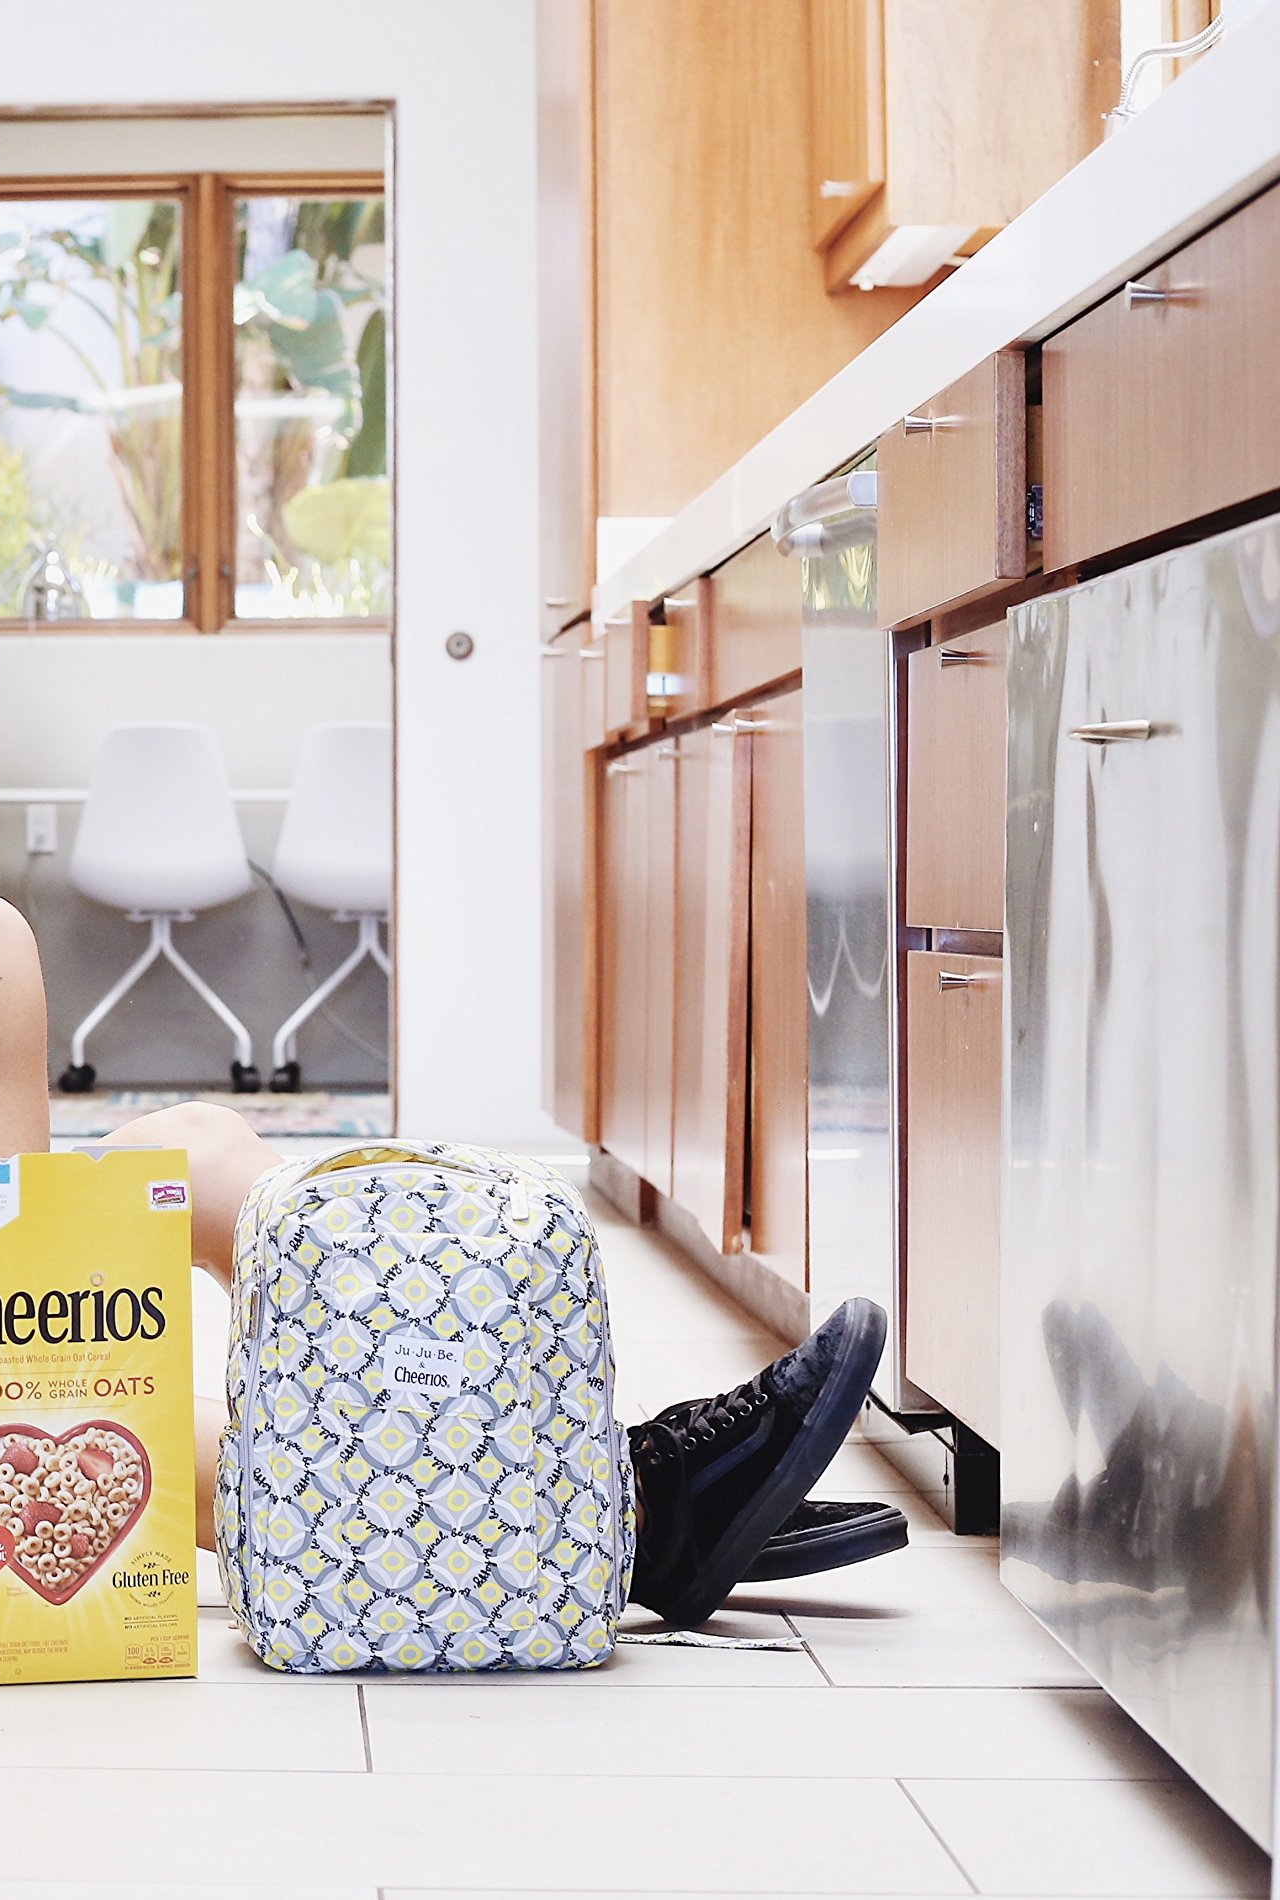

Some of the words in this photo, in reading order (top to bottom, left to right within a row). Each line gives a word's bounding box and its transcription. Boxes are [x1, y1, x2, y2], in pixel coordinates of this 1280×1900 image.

[26, 1354, 49, 1364] Whole
[51, 1353, 71, 1363] Grain
[73, 1353, 86, 1362] Oat
[87, 1352, 111, 1362] Cereal
[48, 1379, 87, 1389] WHOLE
[394, 1366, 448, 1388] Cheerios
[49, 1388, 88, 1399] GRAIN
[94, 1376, 155, 1397] OATS
[112, 1571, 159, 1589] Gluten
[162, 1568, 190, 1586] Free
